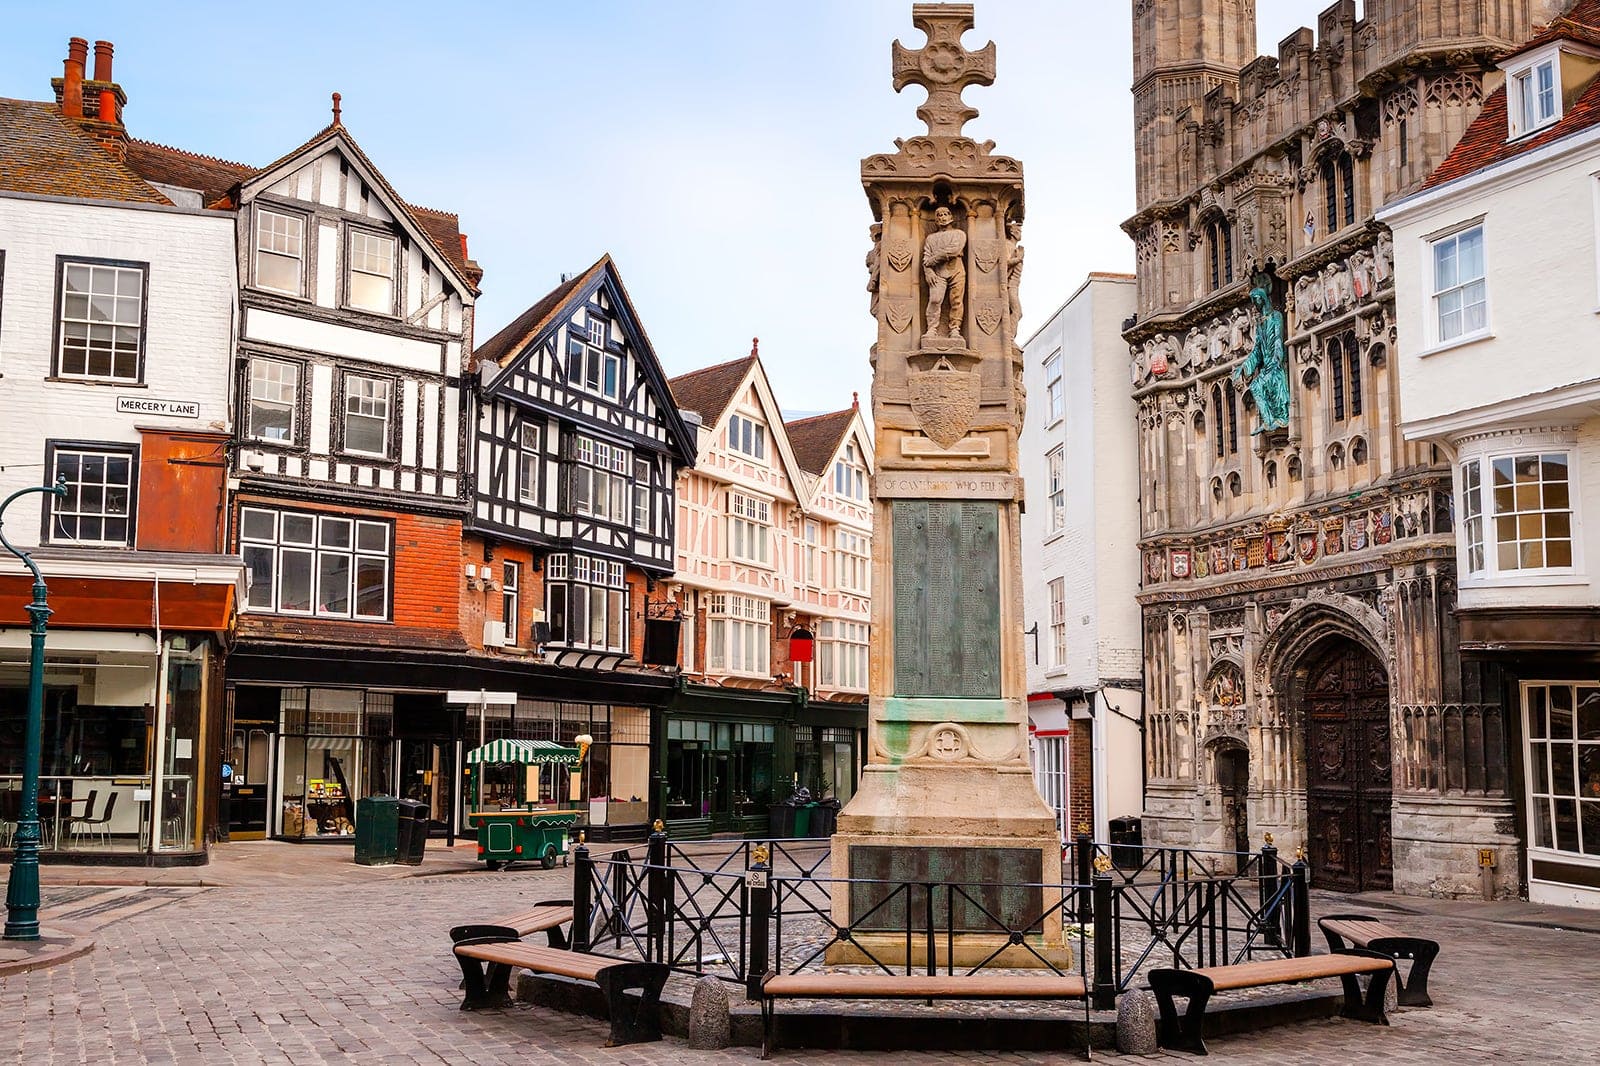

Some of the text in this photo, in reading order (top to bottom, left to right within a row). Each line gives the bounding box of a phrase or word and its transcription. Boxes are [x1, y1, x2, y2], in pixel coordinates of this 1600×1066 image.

[121, 400, 195, 414] MERCERY LANE
[884, 480, 896, 490] OF
[899, 480, 953, 491] CANTER
[955, 481, 977, 491] WHO
[1480, 850, 1493, 865] H
